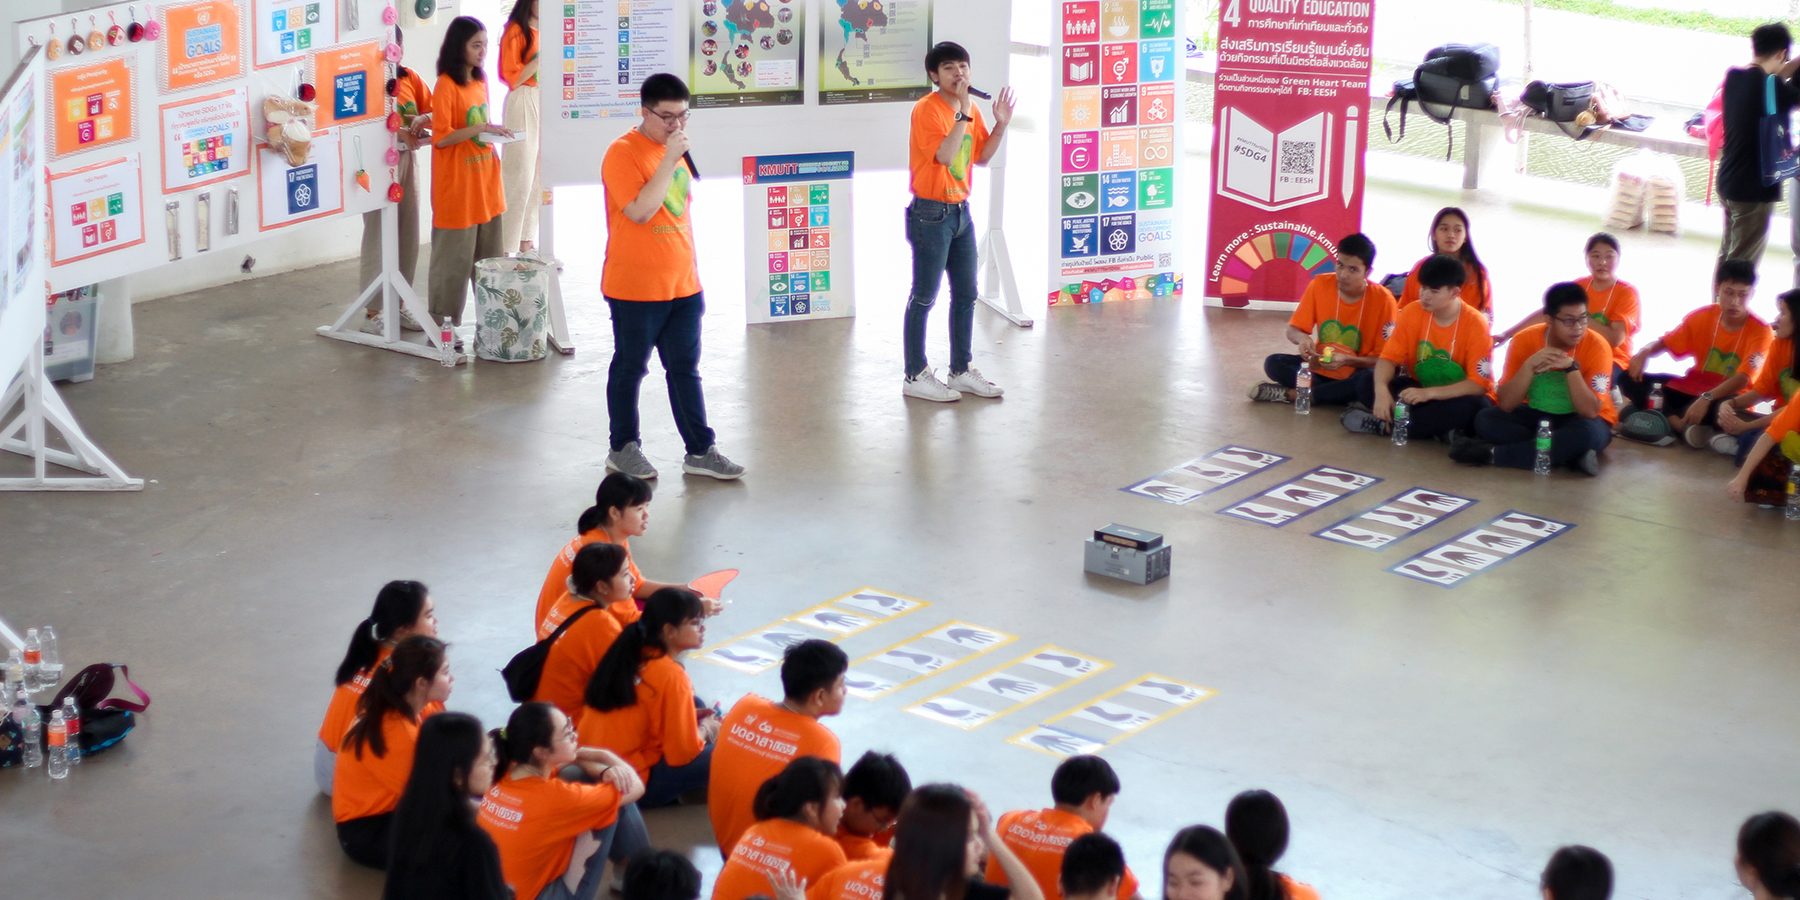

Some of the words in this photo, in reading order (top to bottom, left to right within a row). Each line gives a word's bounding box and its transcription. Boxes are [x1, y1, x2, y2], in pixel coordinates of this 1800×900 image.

[1066, 4, 1070, 14] 1
[1223, 0, 1241, 27] 4
[1249, 0, 1298, 14] QUALITY
[1303, 1, 1369, 17] EDUCATION
[187, 40, 221, 57] GOALS
[1065, 48, 1070, 58] 4
[1104, 46, 1109, 56] 5
[1282, 77, 1310, 86] Green
[1313, 78, 1339, 88] Heart
[1341, 80, 1367, 89] Team
[1103, 89, 1109, 98] 8
[1141, 87, 1146, 96] 9
[1298, 87, 1312, 96] FB:
[1314, 88, 1337, 97] EESH
[1063, 135, 1072, 144] 10
[1234, 144, 1267, 163] #SDG4
[758, 163, 798, 176] KMUTT
[1102, 175, 1110, 184] 14
[1140, 172, 1147, 181] 15
[1063, 177, 1071, 187] 13
[1063, 220, 1071, 230] 16
[1102, 217, 1109, 227] 17
[1138, 230, 1172, 242] GOALS
[1209, 251, 1228, 282] Learn
[1225, 230, 1249, 254] more
